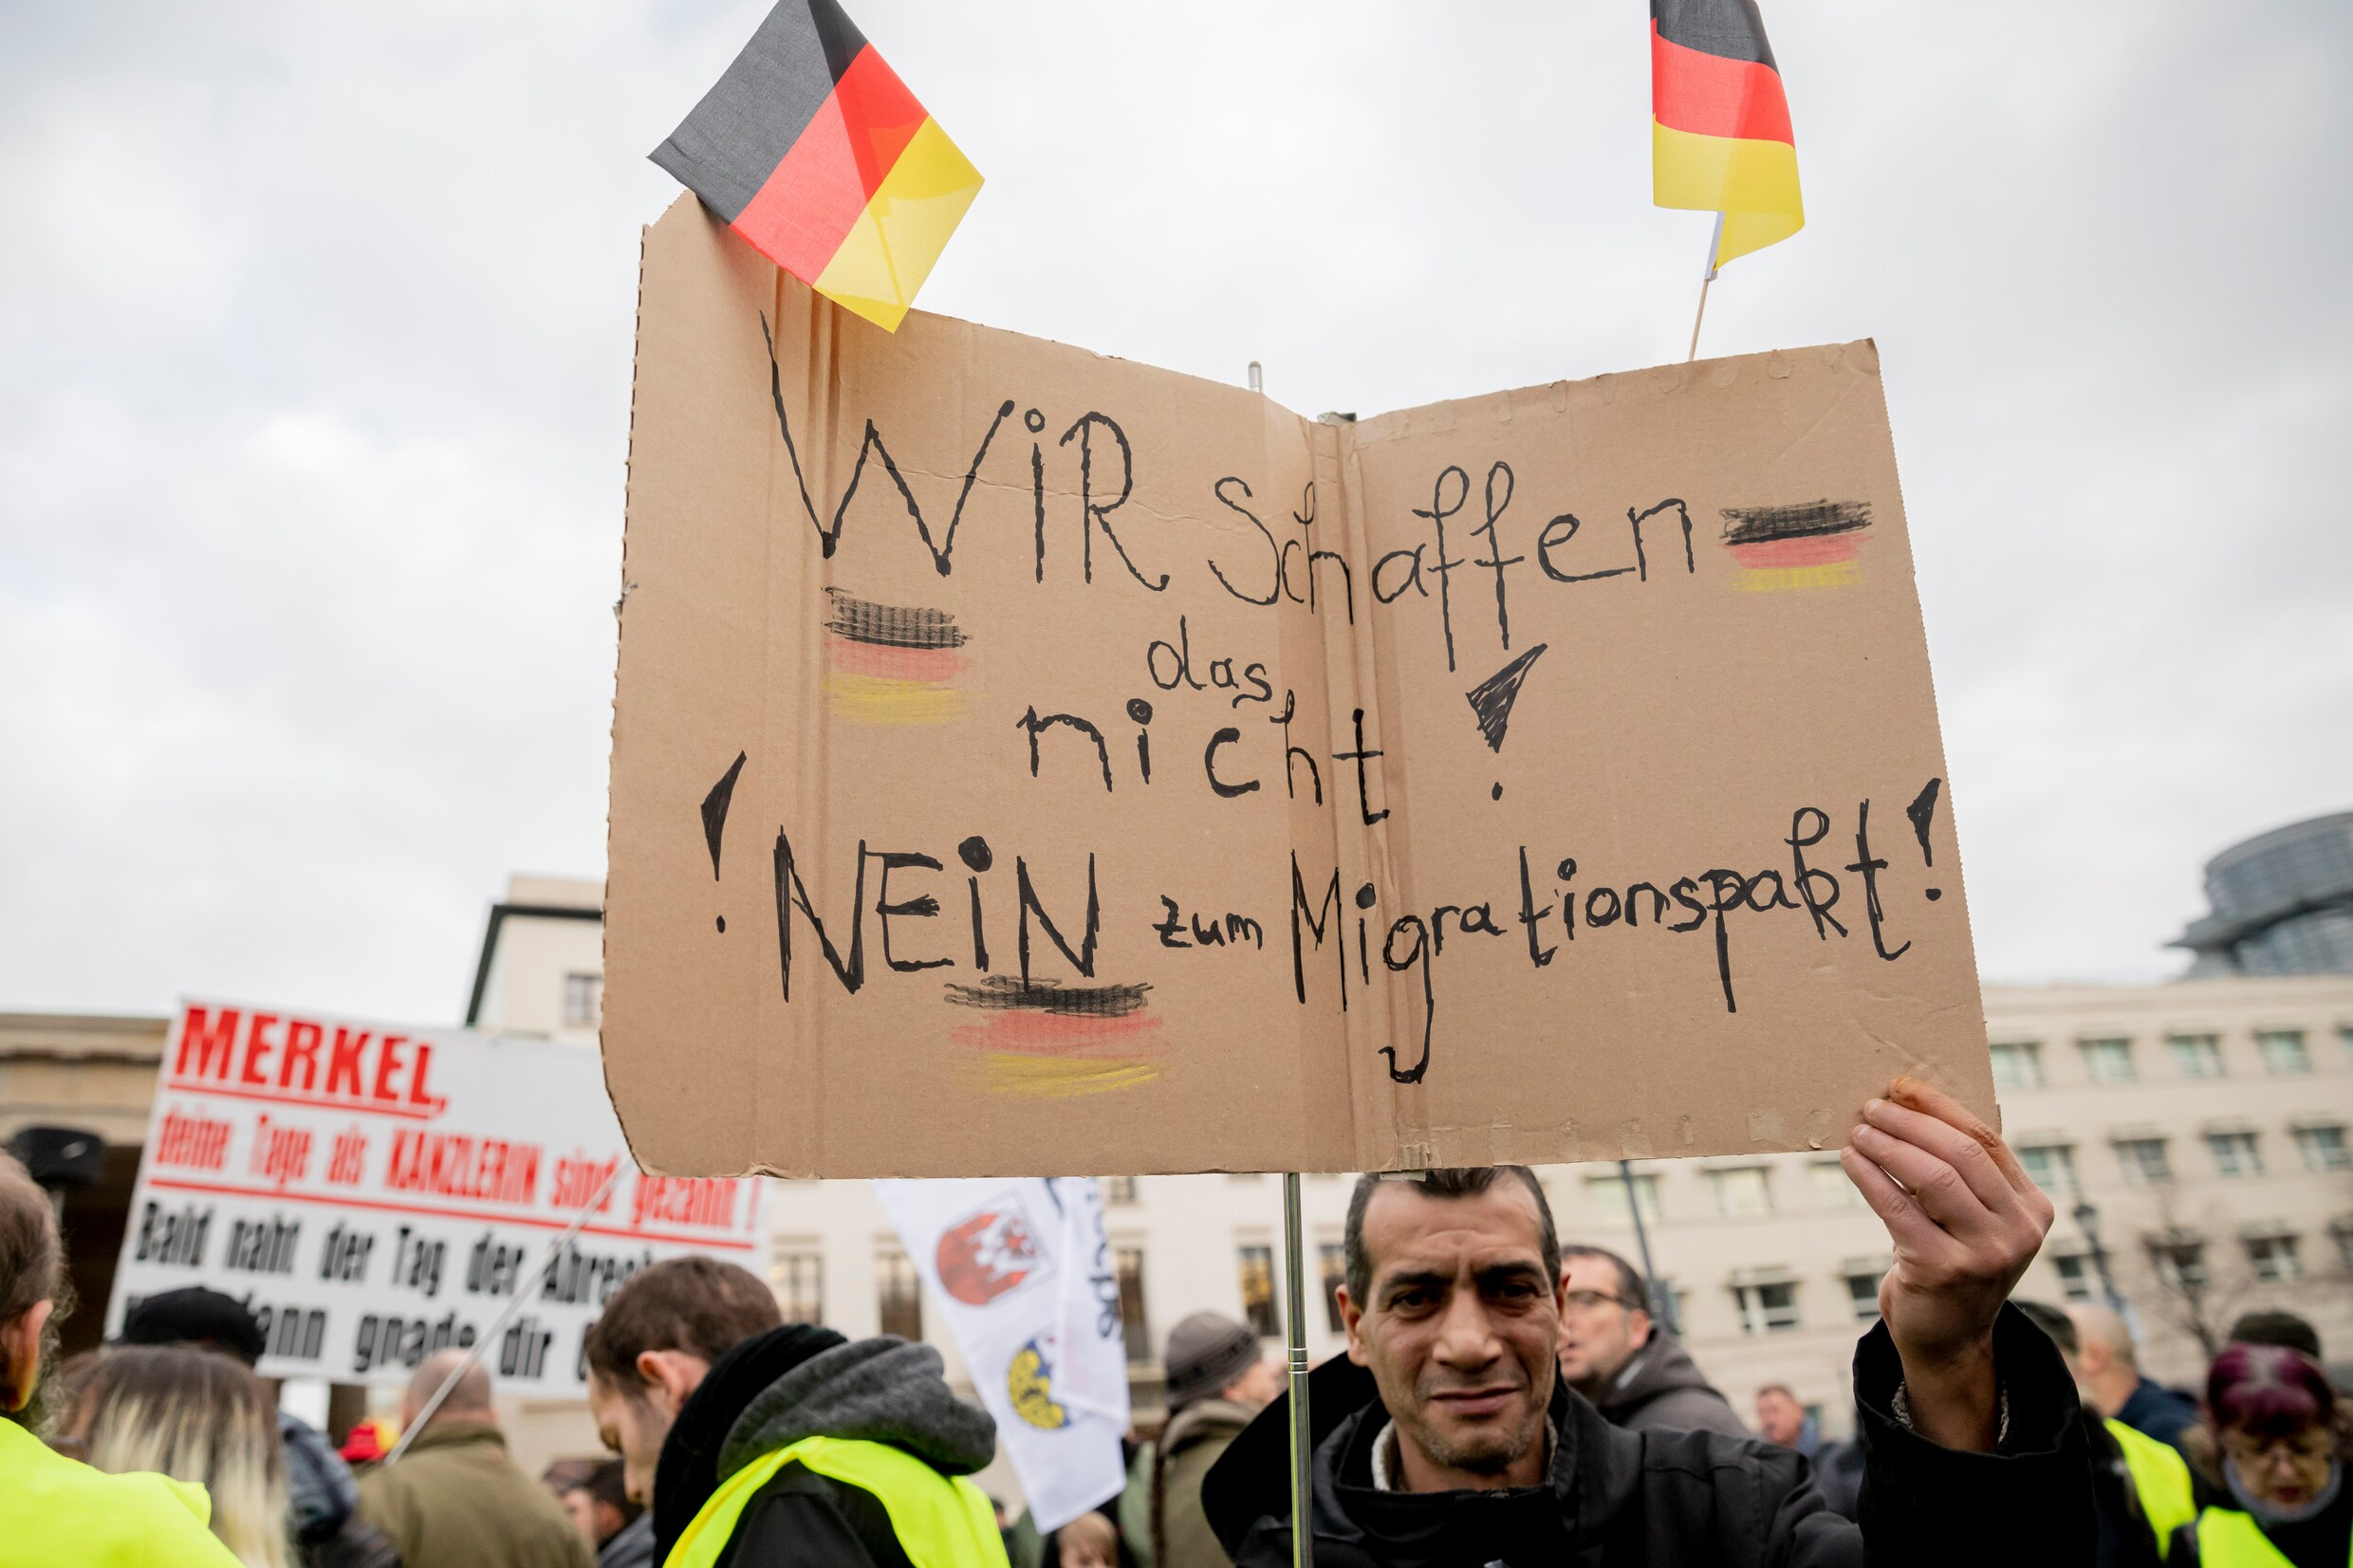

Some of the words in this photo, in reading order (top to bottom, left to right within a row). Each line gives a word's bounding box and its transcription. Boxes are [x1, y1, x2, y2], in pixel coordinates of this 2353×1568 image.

[1147, 615, 1272, 709] das
[1016, 688, 1391, 827] nicht
[1152, 895, 1264, 950] zum
[173, 1007, 448, 1118] MERKEL,
[156, 1106, 232, 1171] deine
[250, 1112, 313, 1188] Tage
[326, 1127, 367, 1186] als
[385, 1127, 543, 1205] KANZLERIN
[551, 1148, 621, 1213] sind
[137, 1201, 213, 1265] Bald
[224, 1213, 299, 1273] naht
[319, 1221, 373, 1281] der
[391, 1227, 447, 1297] Tag
[466, 1232, 525, 1296] der
[499, 1317, 553, 1379] dir
